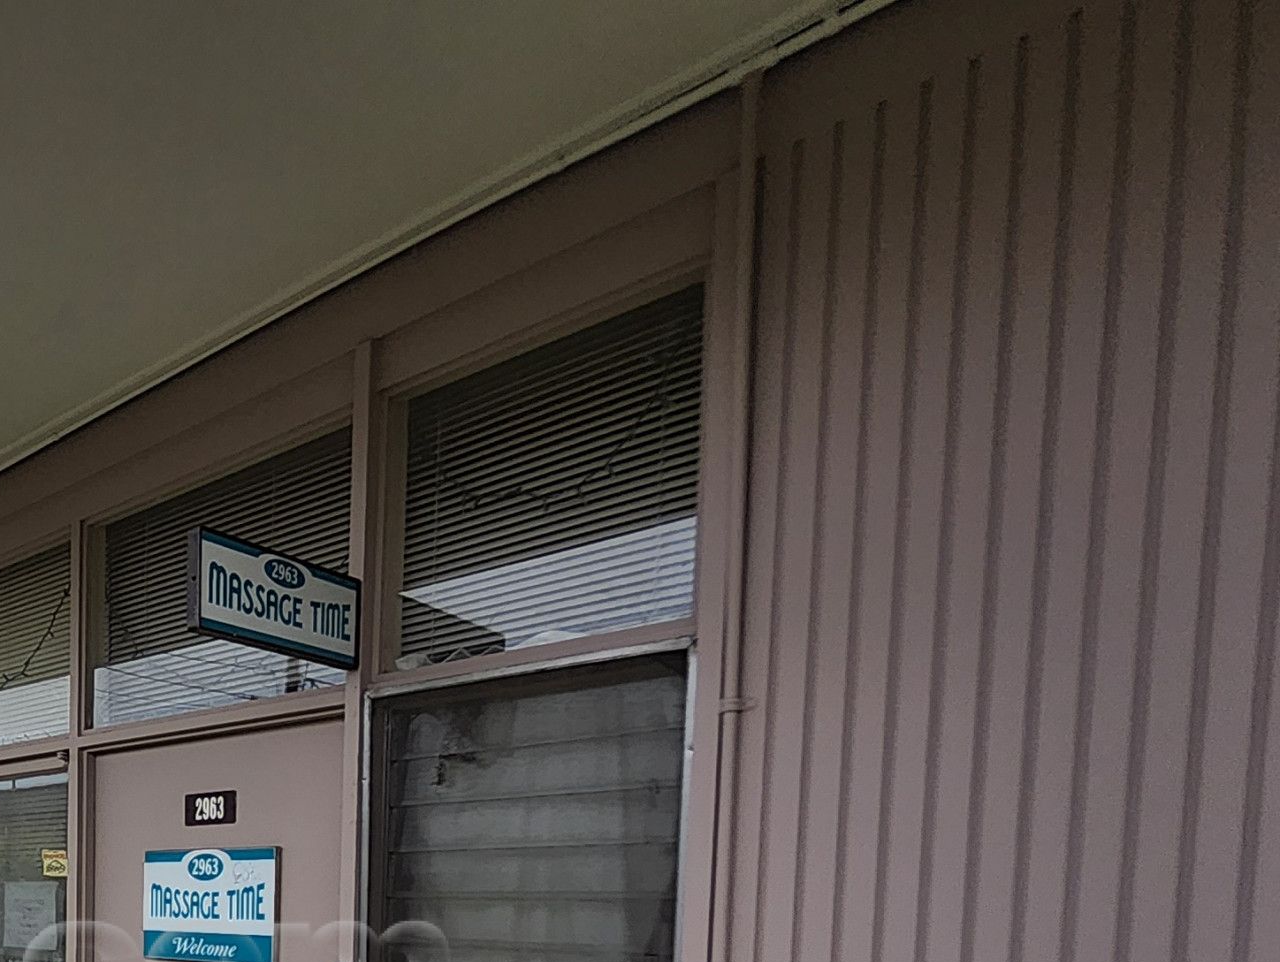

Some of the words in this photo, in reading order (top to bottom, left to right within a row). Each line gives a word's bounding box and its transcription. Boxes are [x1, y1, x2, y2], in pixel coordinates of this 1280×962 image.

[271, 561, 298, 586] 2963
[208, 560, 303, 629] MASSAGE
[310, 600, 351, 642] TIME
[195, 796, 224, 821] 2963
[192, 857, 219, 876] 2963
[150, 883, 220, 920] MASSAGE
[226, 882, 266, 921] TIME
[172, 936, 238, 958] Welcome
